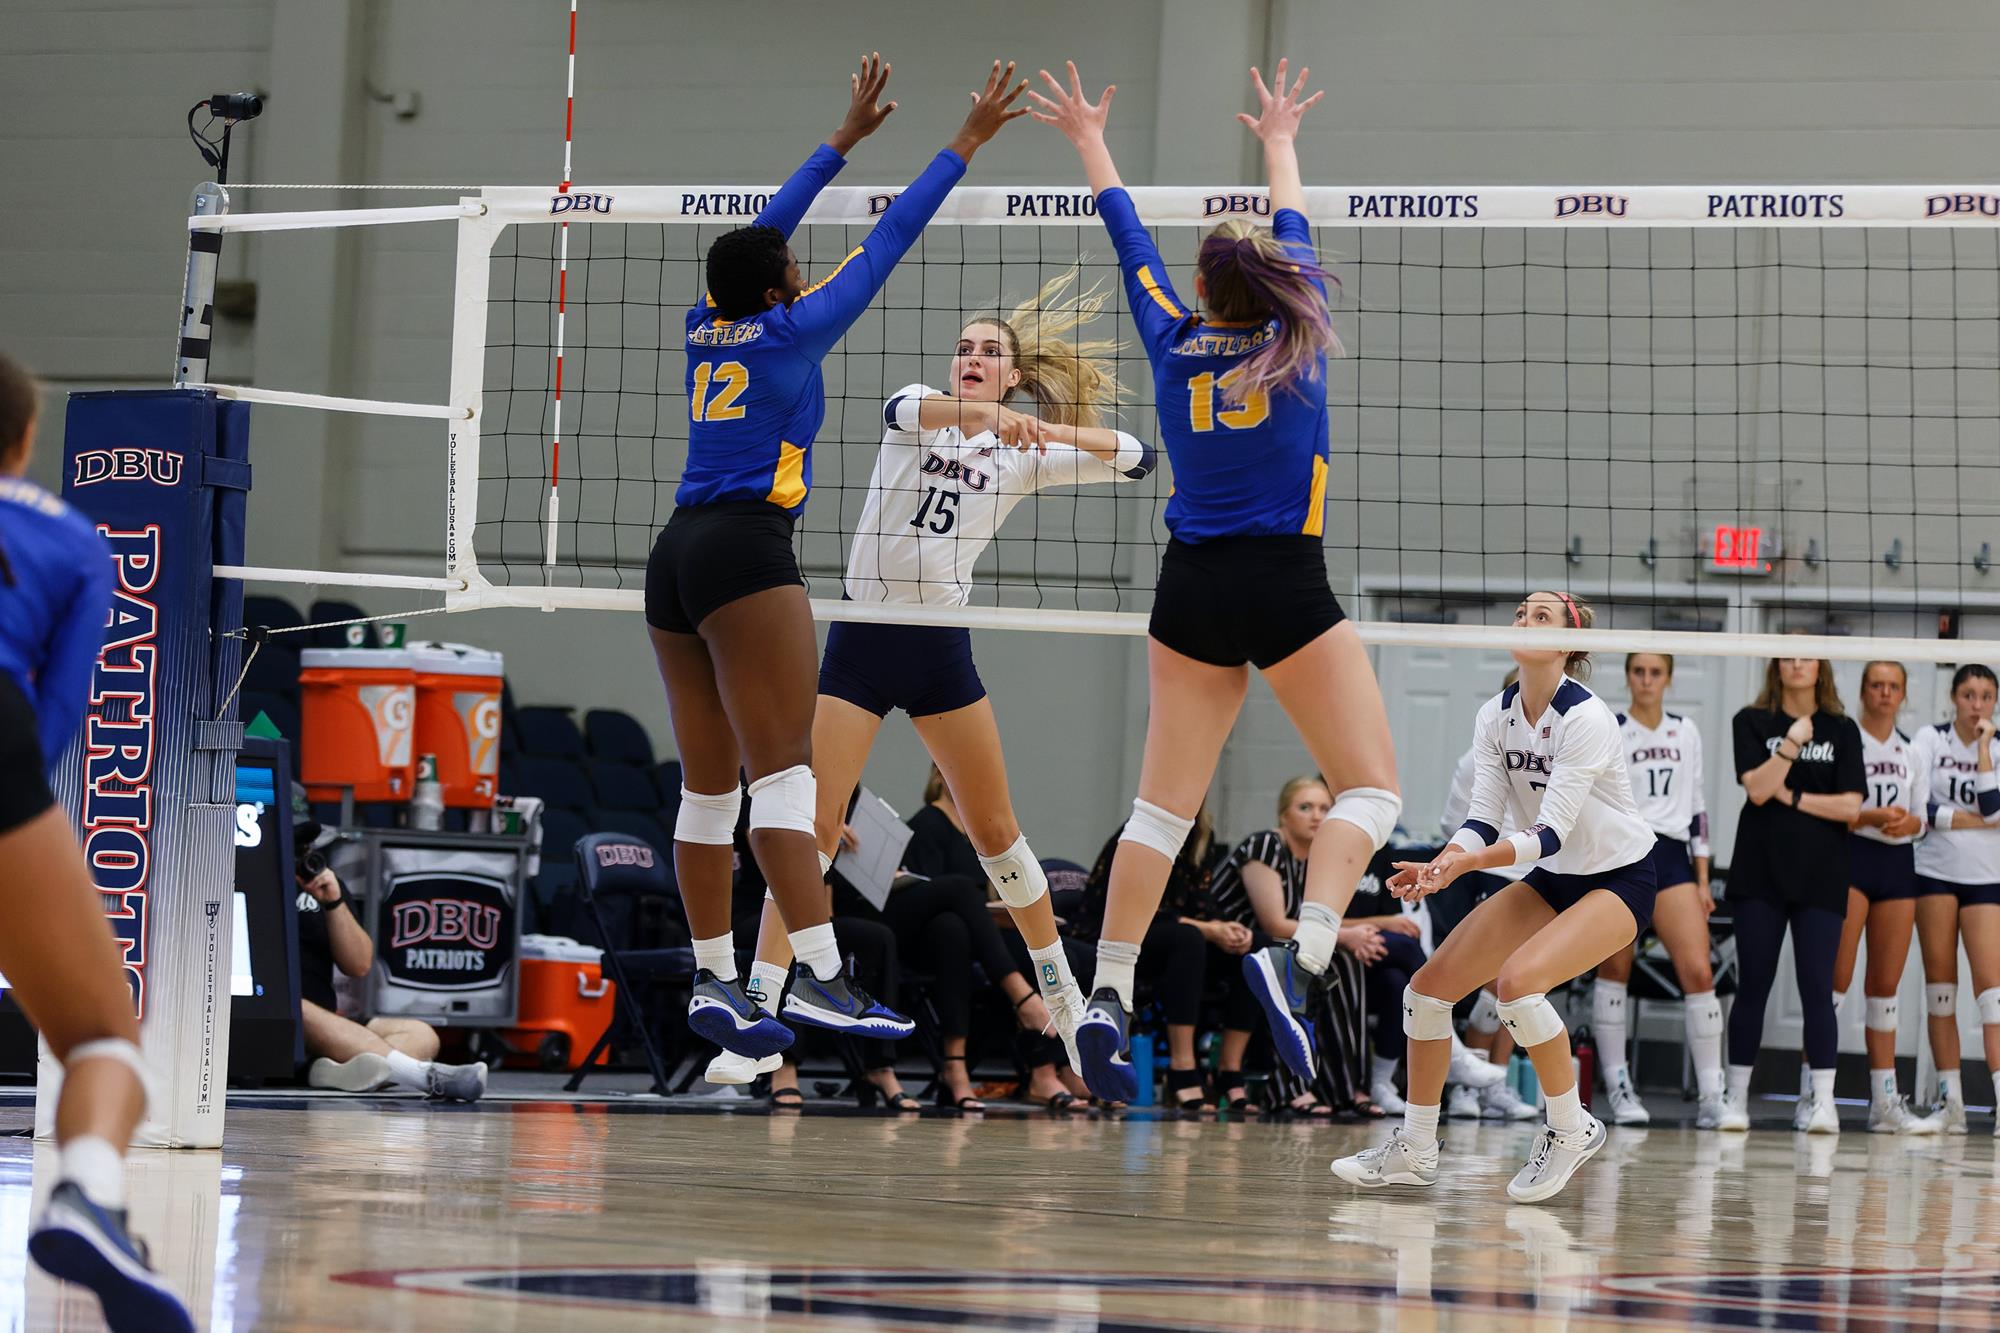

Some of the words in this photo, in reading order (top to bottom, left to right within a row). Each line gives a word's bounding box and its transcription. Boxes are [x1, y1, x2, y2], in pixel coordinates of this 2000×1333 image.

[550, 193, 614, 216] DBU
[681, 194, 776, 216] PATRIO
[1006, 194, 1097, 216] PATRIO
[1203, 194, 1271, 217] DBU
[1349, 195, 1478, 217] PATRIOTS
[1555, 194, 1629, 218] DBU
[1707, 195, 1844, 218] PATRIOTS
[1926, 194, 2000, 217] DBU
[692, 361, 749, 421] 12
[74, 448, 183, 487] DBU
[920, 452, 991, 492] DBU
[909, 486, 960, 534] 15
[1714, 526, 1761, 568] EXIT
[1632, 747, 1681, 763] DBU
[1648, 768, 1673, 797] 17
[1875, 782, 1898, 808] 12
[1948, 776, 1976, 805] 16
[597, 844, 654, 868] DBU
[392, 899, 501, 949] DBU
[406, 949, 485, 971] PATRIOTS
